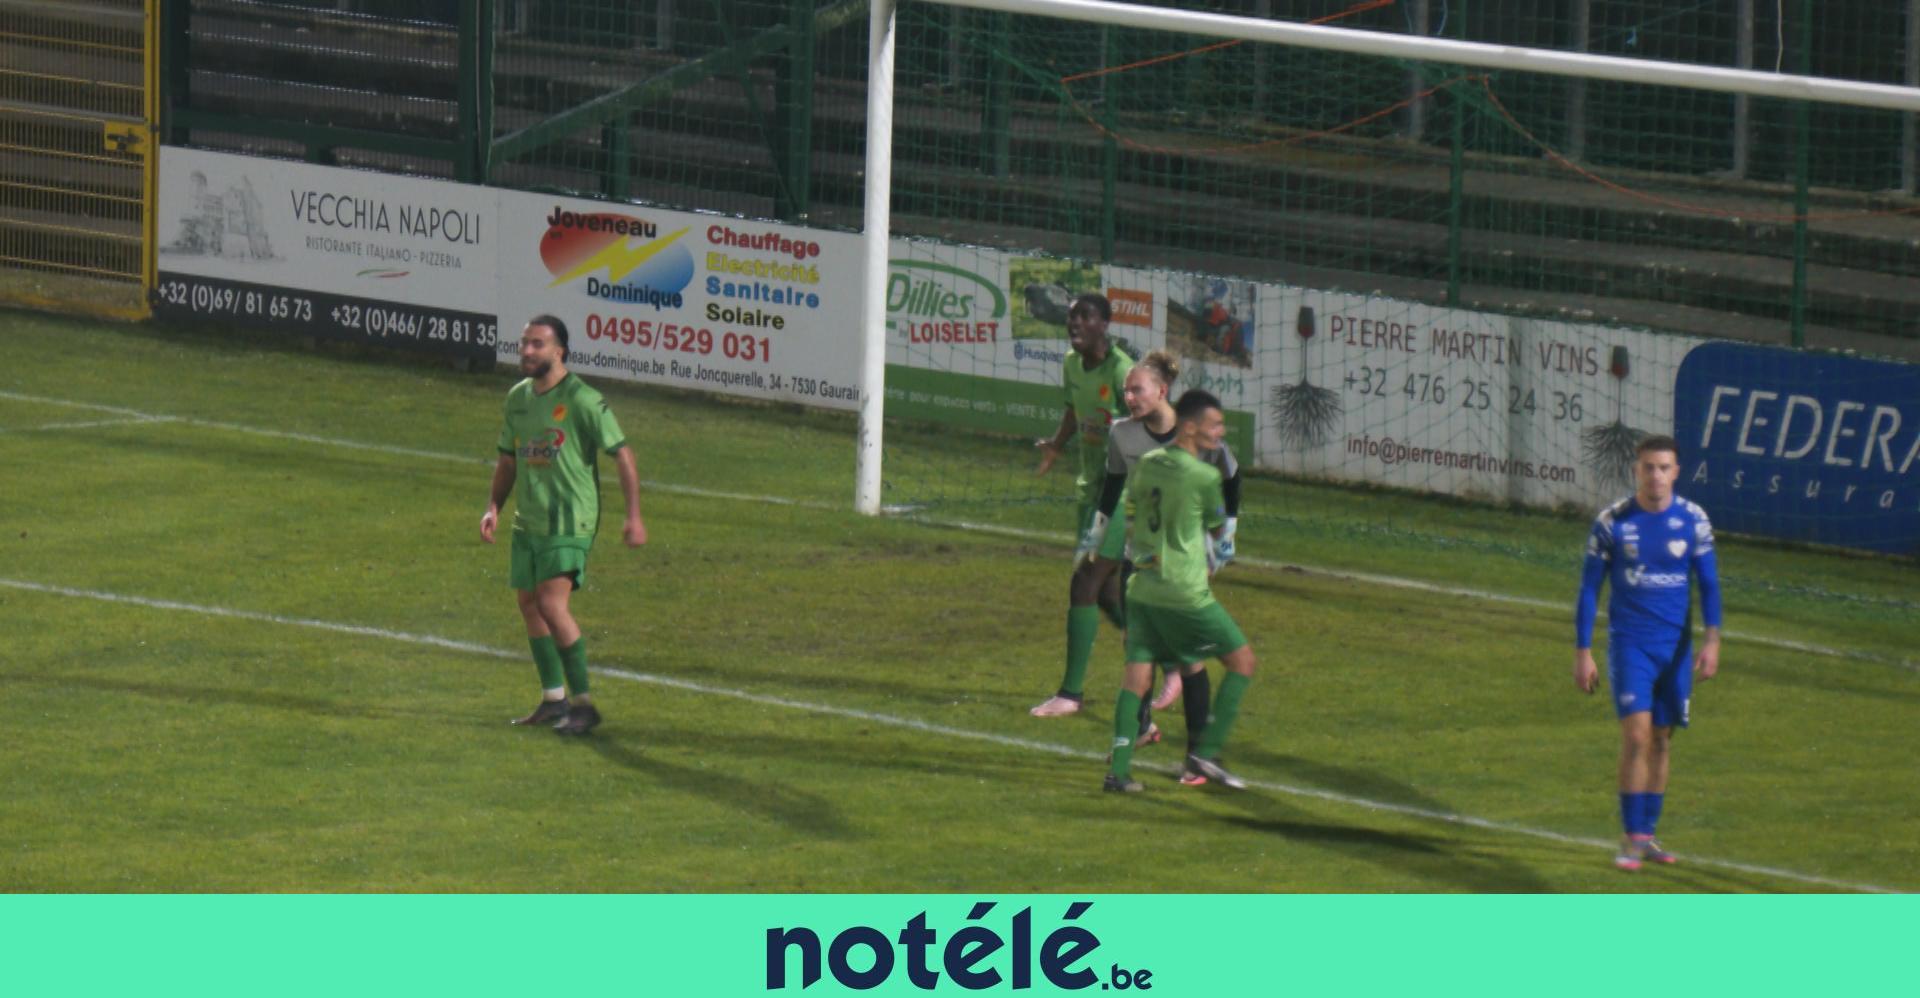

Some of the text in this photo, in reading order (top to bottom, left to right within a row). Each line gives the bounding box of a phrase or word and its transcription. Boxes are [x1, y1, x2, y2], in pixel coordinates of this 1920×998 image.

[290, 189, 480, 245] VECCHIA NAPOLI
[547, 206, 657, 239] Joveneau
[305, 236, 362, 257] RISTORANTE
[366, 241, 410, 263] ITALIANO
[419, 250, 462, 269] PIZZERIA
[706, 225, 820, 259] Chauffage
[706, 251, 820, 285] Electricité
[158, 281, 312, 321] +32 (0)69/ 81 65 73
[587, 276, 684, 311] Dominique
[705, 275, 820, 309] Sanitaire
[886, 272, 974, 319] Dillies
[1111, 299, 1150, 316] STIHL
[331, 305, 496, 347] +32 (0)466/ 28 81 35
[705, 303, 785, 330] Solaire
[910, 320, 999, 344] LOISELET
[586, 313, 771, 363] 0495/529 031
[1331, 315, 1598, 376] PIERRE MARTIN VINS
[671, 361, 692, 379] Rue
[694, 364, 767, 391] Joncquerelle,
[769, 372, 783, 390] 34
[791, 376, 816, 396] 7530
[1343, 365, 1583, 422] +32 476 25 24 36
[1347, 433, 1576, 484] info@pierremartinvins.com
[1147, 487, 1162, 533] 3
